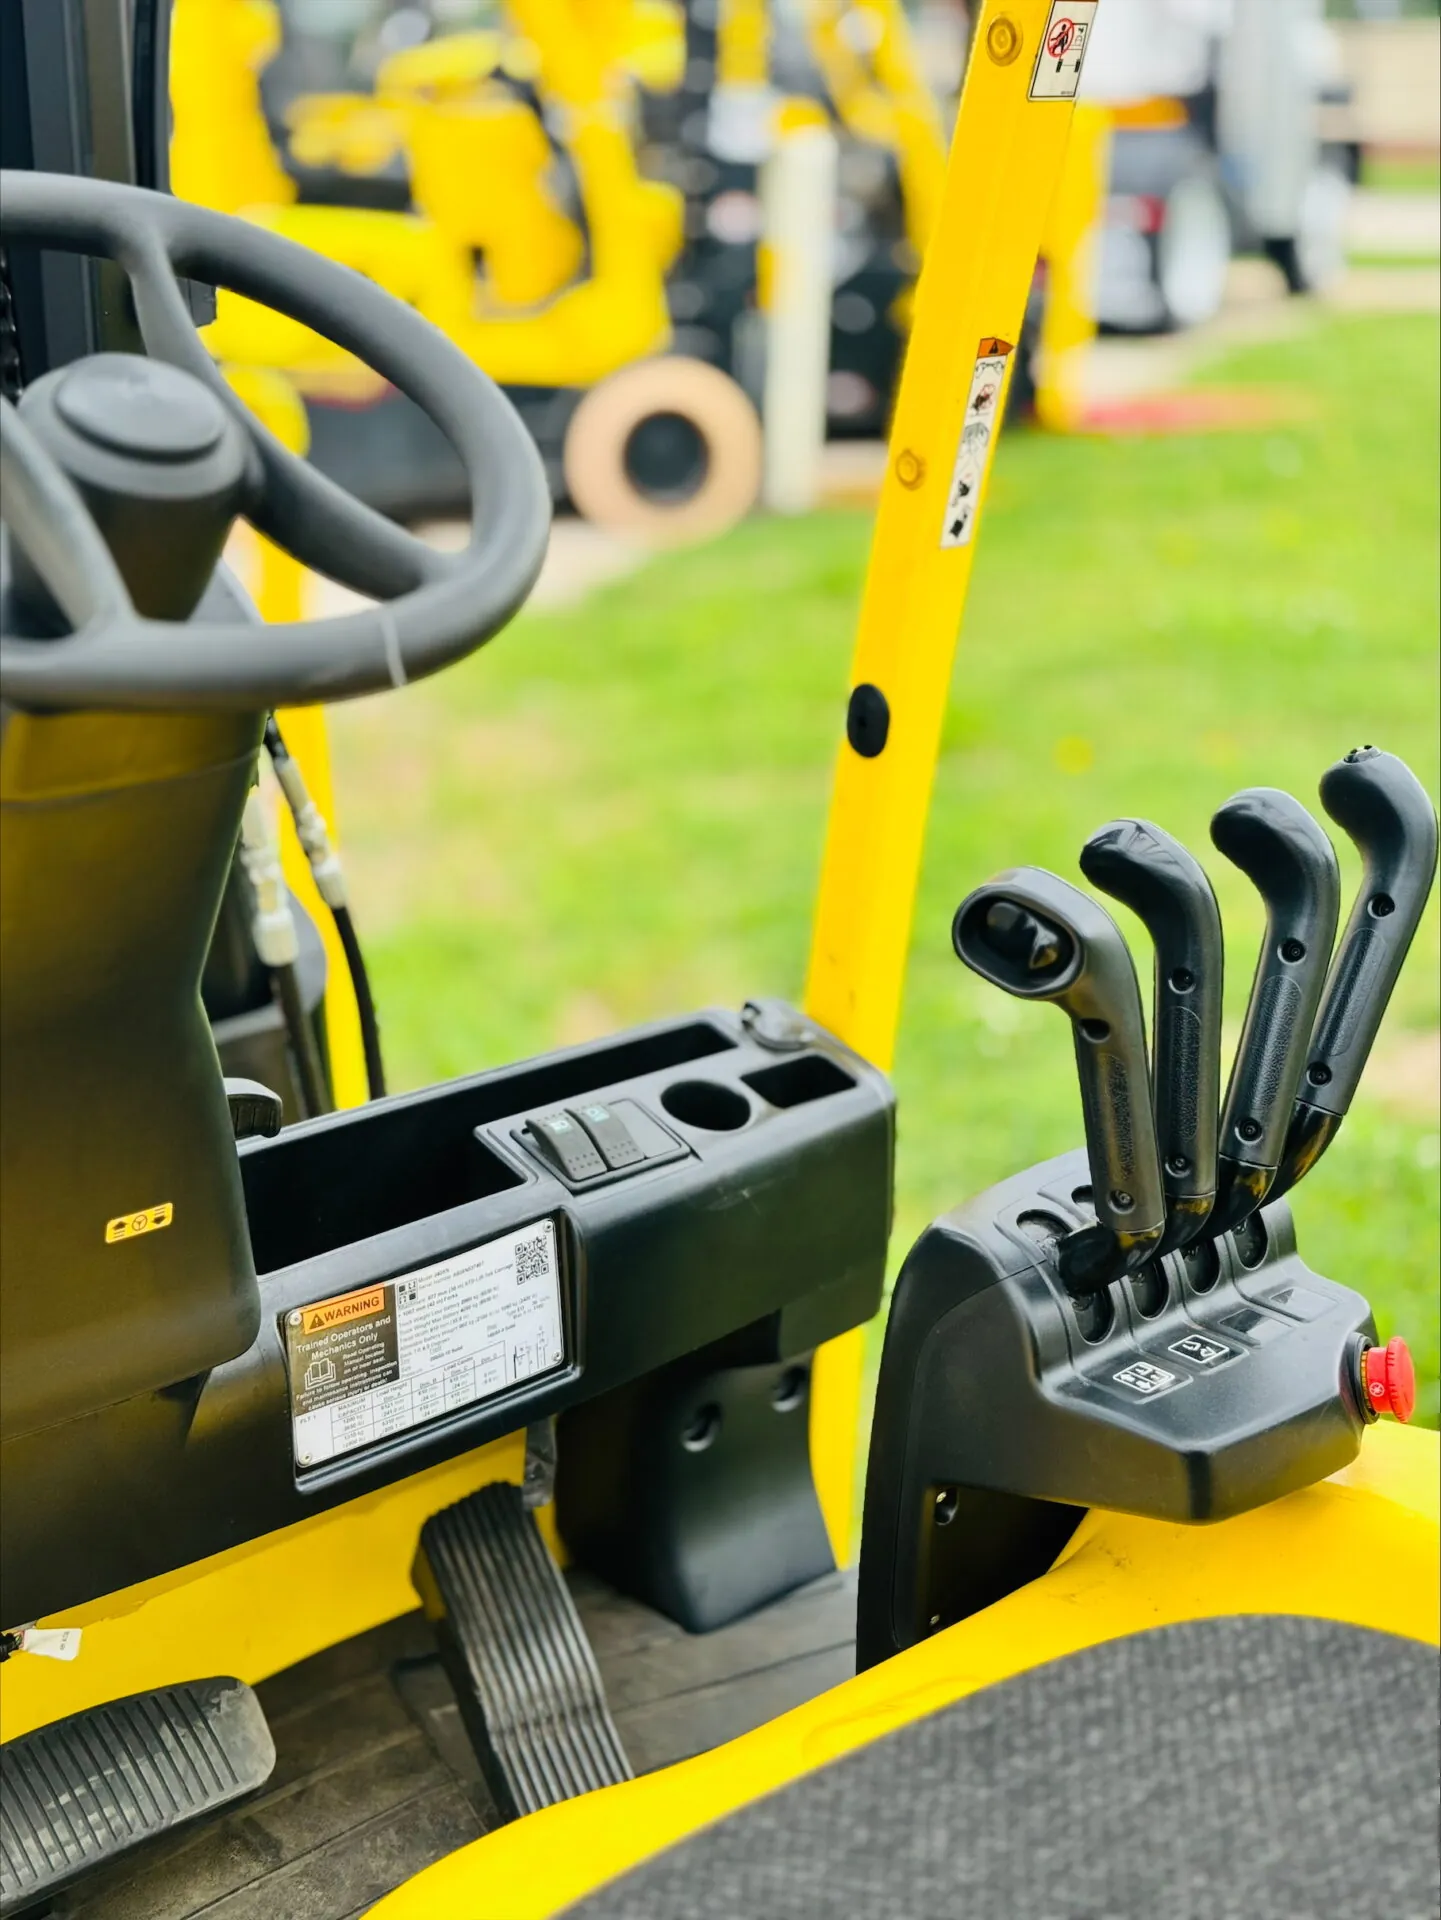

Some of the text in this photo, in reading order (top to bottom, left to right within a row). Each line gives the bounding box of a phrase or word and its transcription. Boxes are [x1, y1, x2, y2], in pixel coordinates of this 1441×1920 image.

[323, 1296, 380, 1322] WARNING
[296, 1316, 391, 1353] Trained Operators and
[312, 1332, 378, 1361] Mechanics Only
[343, 1342, 384, 1359] Read Operating
[344, 1349, 384, 1367] Manual located
[359, 1361, 371, 1369] near
[296, 1391, 315, 1400] Failure
[324, 1382, 340, 1391] follow
[370, 1361, 397, 1374] inspection
[314, 1385, 348, 1401] maintenance
[350, 1374, 381, 1388] instructions
[309, 1401, 325, 1410] cause
[327, 1394, 346, 1404] serious
[348, 1388, 363, 1399] injury
[338, 1403, 366, 1418] CAPACITY
